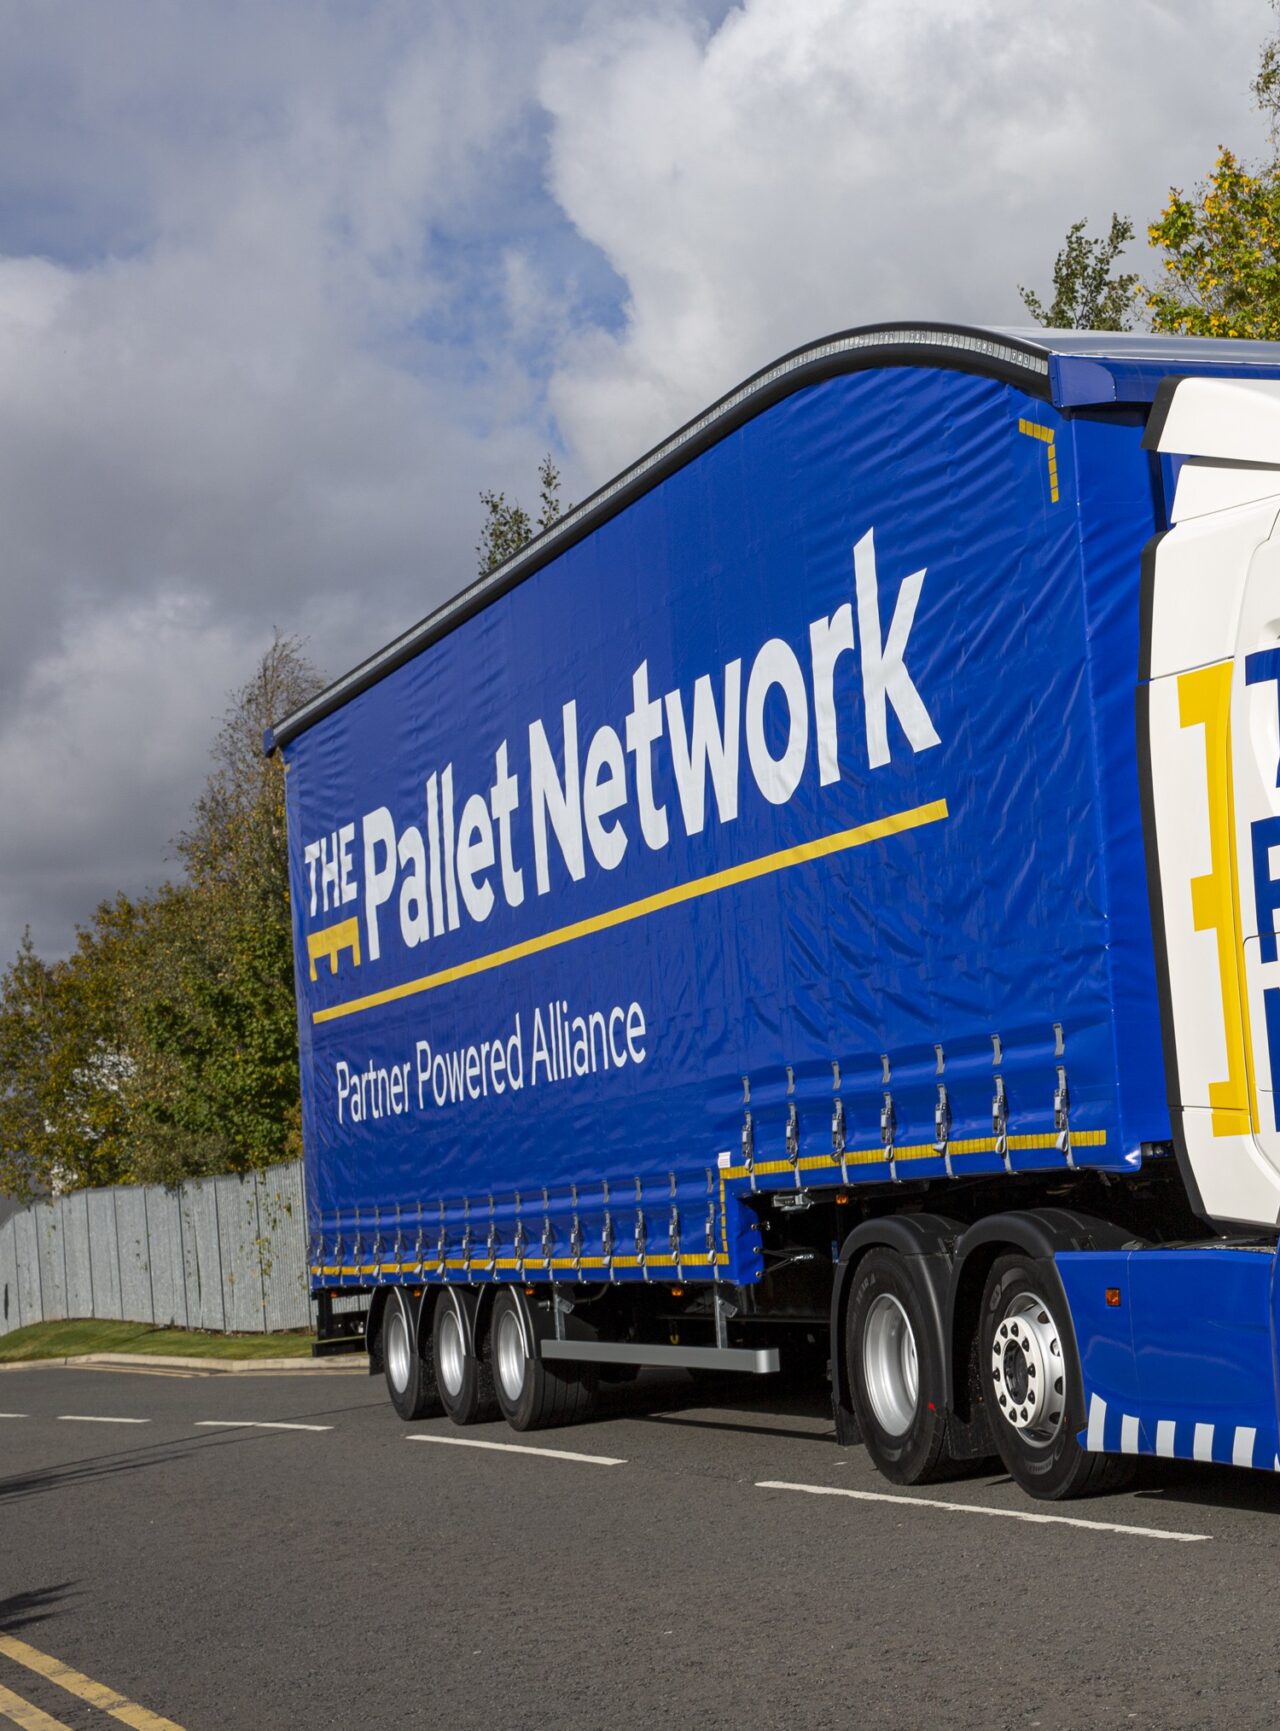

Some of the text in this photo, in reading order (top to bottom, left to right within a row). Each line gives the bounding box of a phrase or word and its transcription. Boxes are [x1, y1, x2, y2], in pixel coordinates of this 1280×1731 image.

[304, 822, 359, 917] THE
[336, 1000, 647, 1124] Partner Powered Alliance
